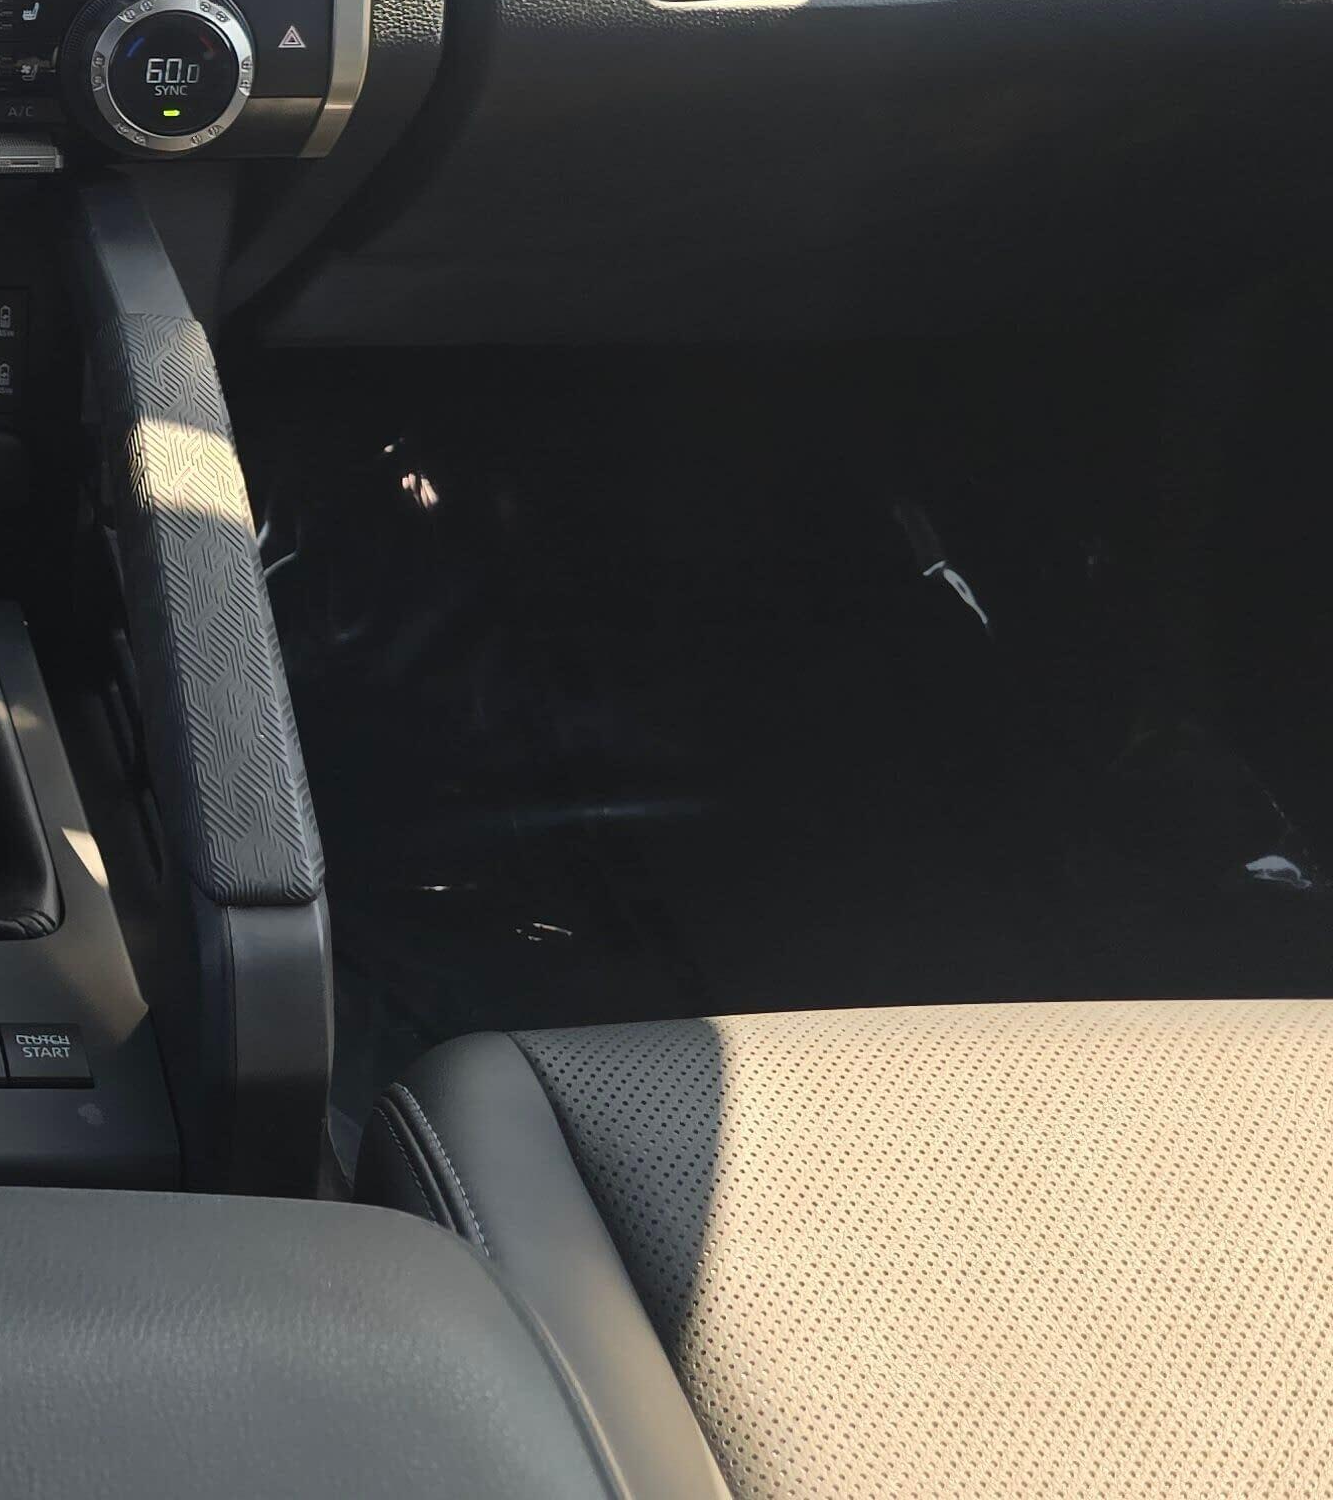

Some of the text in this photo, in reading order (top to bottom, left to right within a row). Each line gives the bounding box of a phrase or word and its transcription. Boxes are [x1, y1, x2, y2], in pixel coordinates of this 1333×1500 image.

[145, 57, 201, 84] 60.0
[154, 85, 188, 96] SYNC
[7, 106, 35, 118] A/C
[22, 1046, 71, 1059] START
